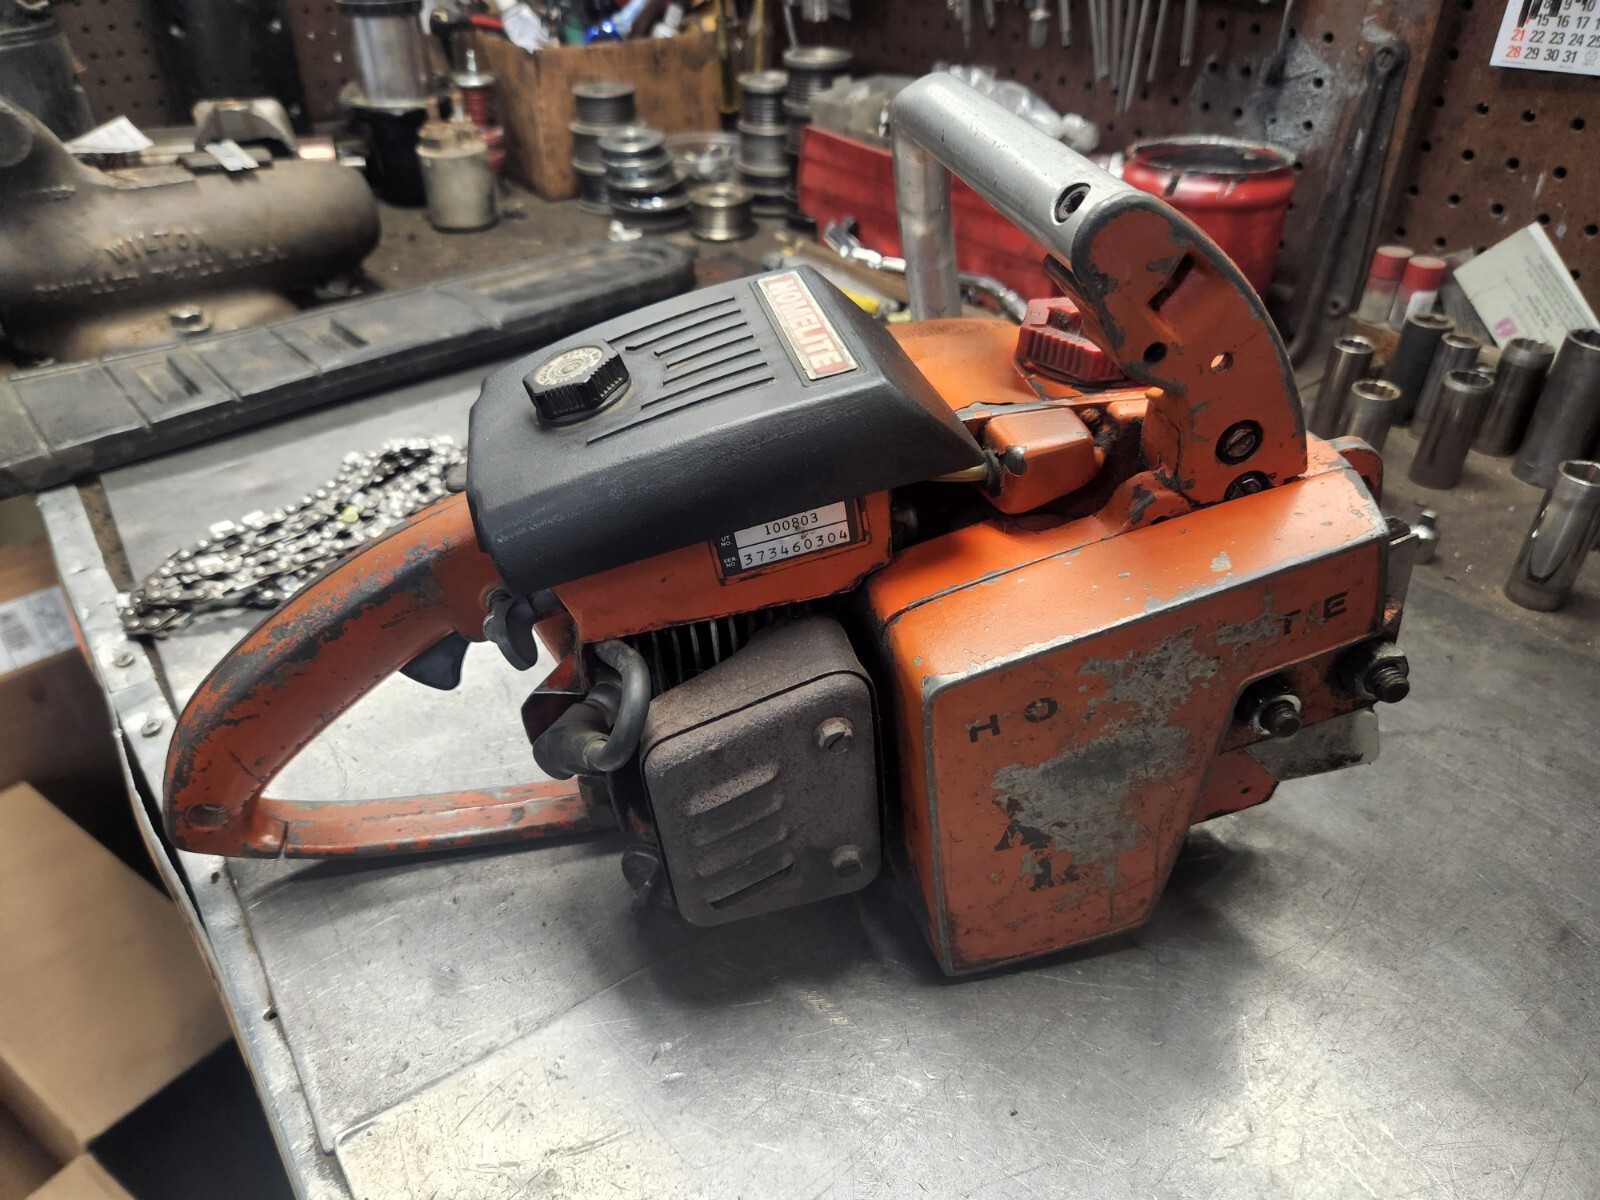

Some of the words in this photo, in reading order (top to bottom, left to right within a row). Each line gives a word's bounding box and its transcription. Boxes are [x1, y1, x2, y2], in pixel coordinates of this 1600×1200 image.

[1563, 0, 1573, 10] 9
[1536, 14, 1550, 27] 15
[1556, 15, 1571, 28] 16
[1576, 16, 1591, 29] 17
[1510, 28, 1526, 42] 21
[1528, 29, 1546, 43] 22
[1548, 31, 1566, 45] 23
[1568, 33, 1585, 47] 24
[1505, 45, 1522, 58] 28
[1523, 46, 1540, 60] 29
[1543, 48, 1560, 62] 30
[1562, 50, 1578, 63] 31
[767, 279, 843, 369] HOMELITE
[764, 512, 819, 536] 100803
[743, 530, 848, 566] 373460304
